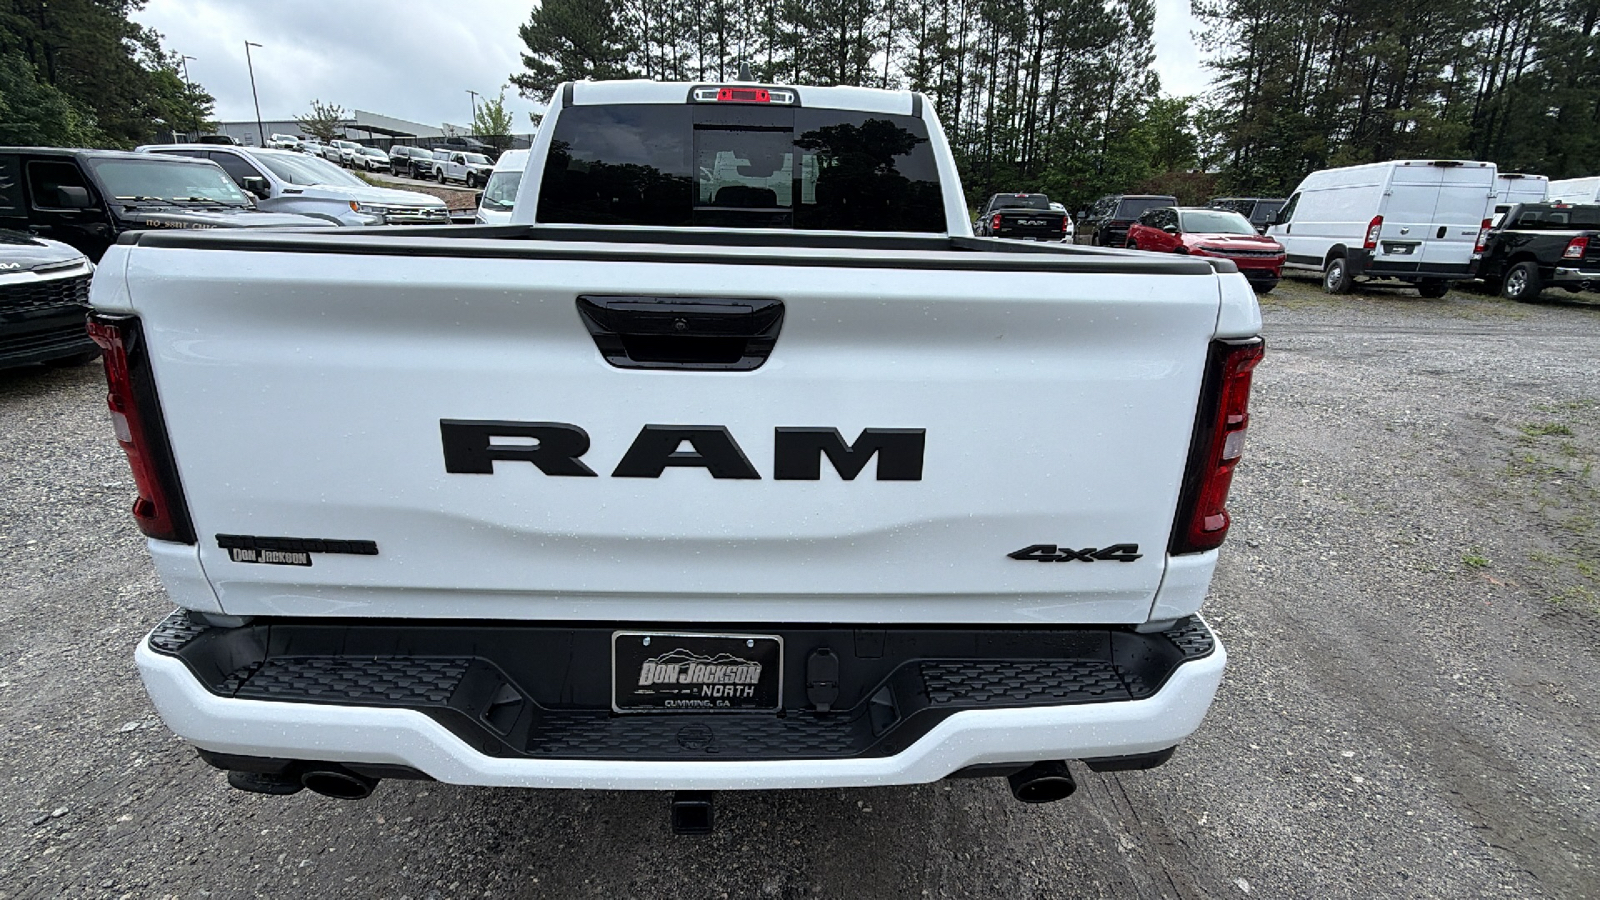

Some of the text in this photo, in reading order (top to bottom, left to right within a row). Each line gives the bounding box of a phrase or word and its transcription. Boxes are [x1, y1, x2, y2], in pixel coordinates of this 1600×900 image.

[439, 418, 927, 481] RAM
[1006, 543, 1143, 562] 4x4
[701, 685, 755, 697] NORTH
